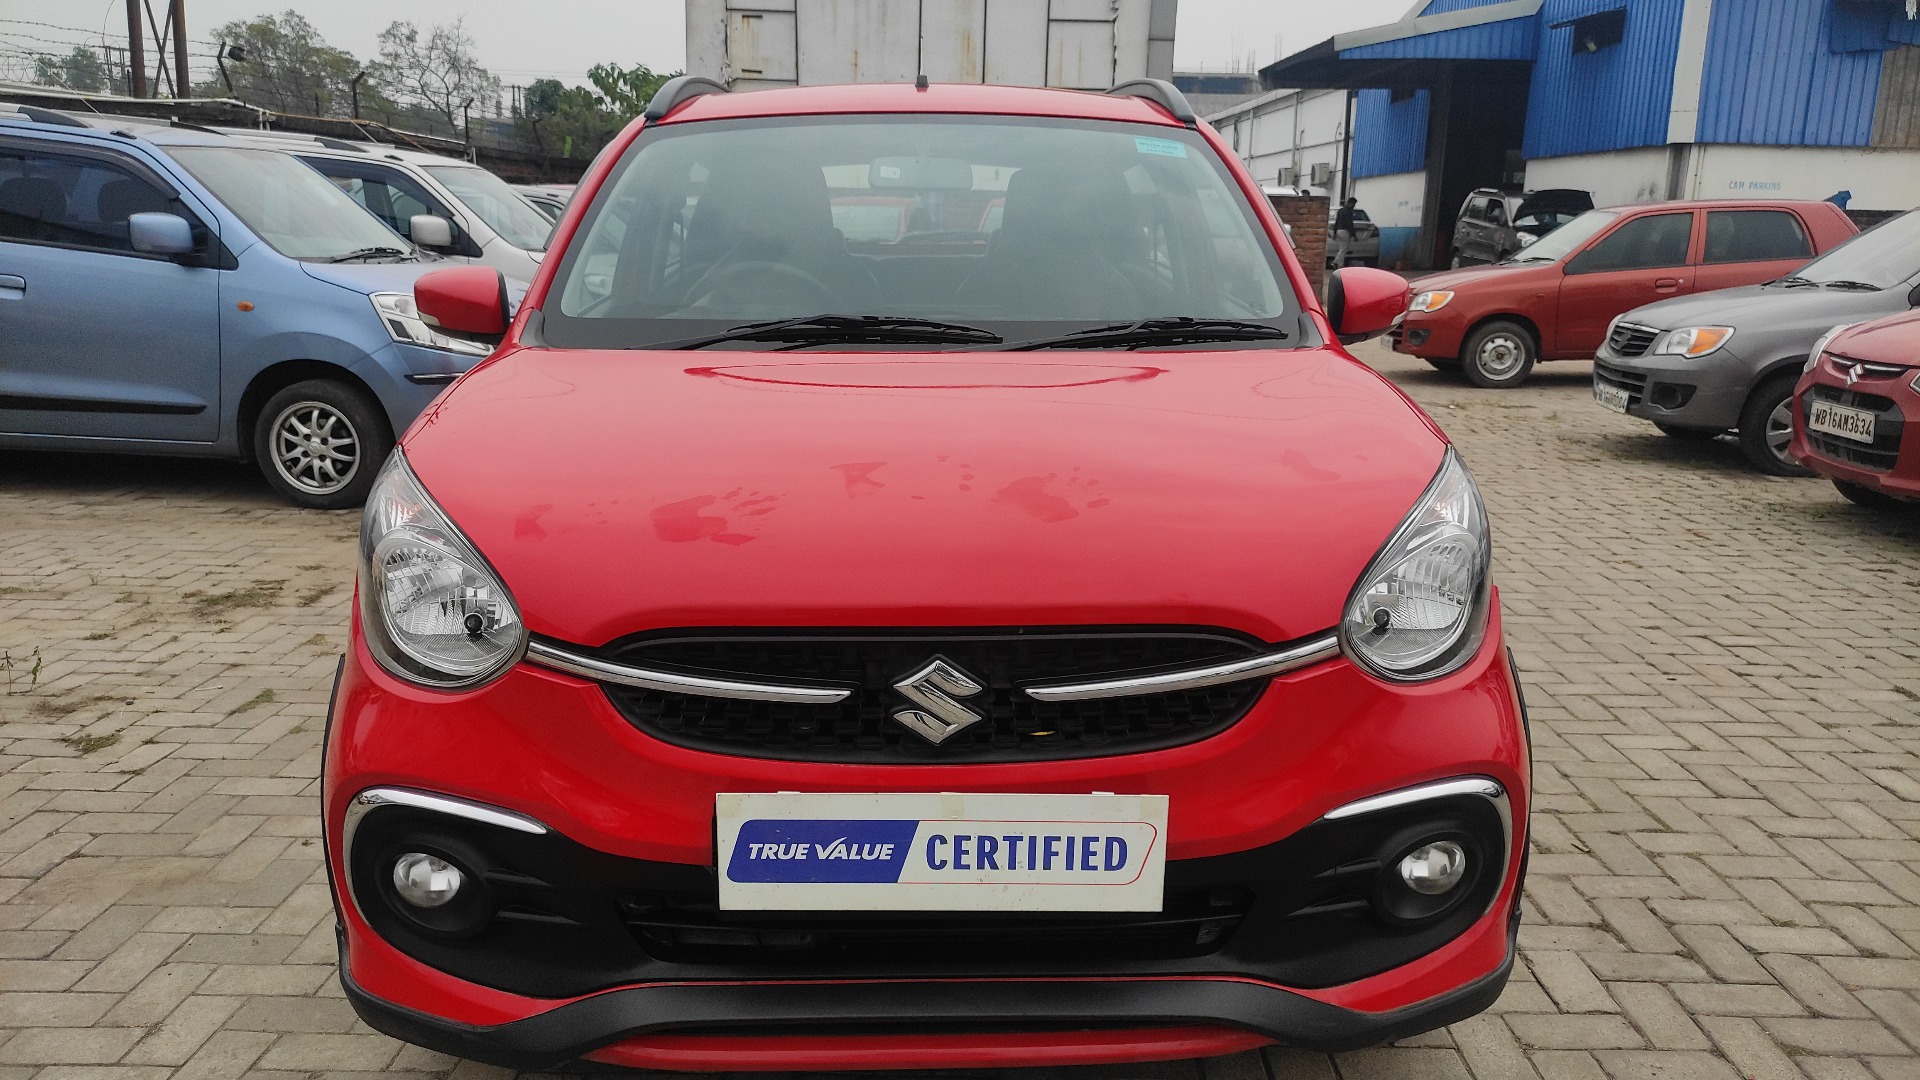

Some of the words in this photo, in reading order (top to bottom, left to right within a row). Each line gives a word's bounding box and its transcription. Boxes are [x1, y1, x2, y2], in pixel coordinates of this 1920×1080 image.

[1728, 181, 1745, 190] CAR
[748, 843, 811, 860] TRUE
[814, 836, 895, 860] VALUE
[925, 834, 1128, 871] CERTIFIED
